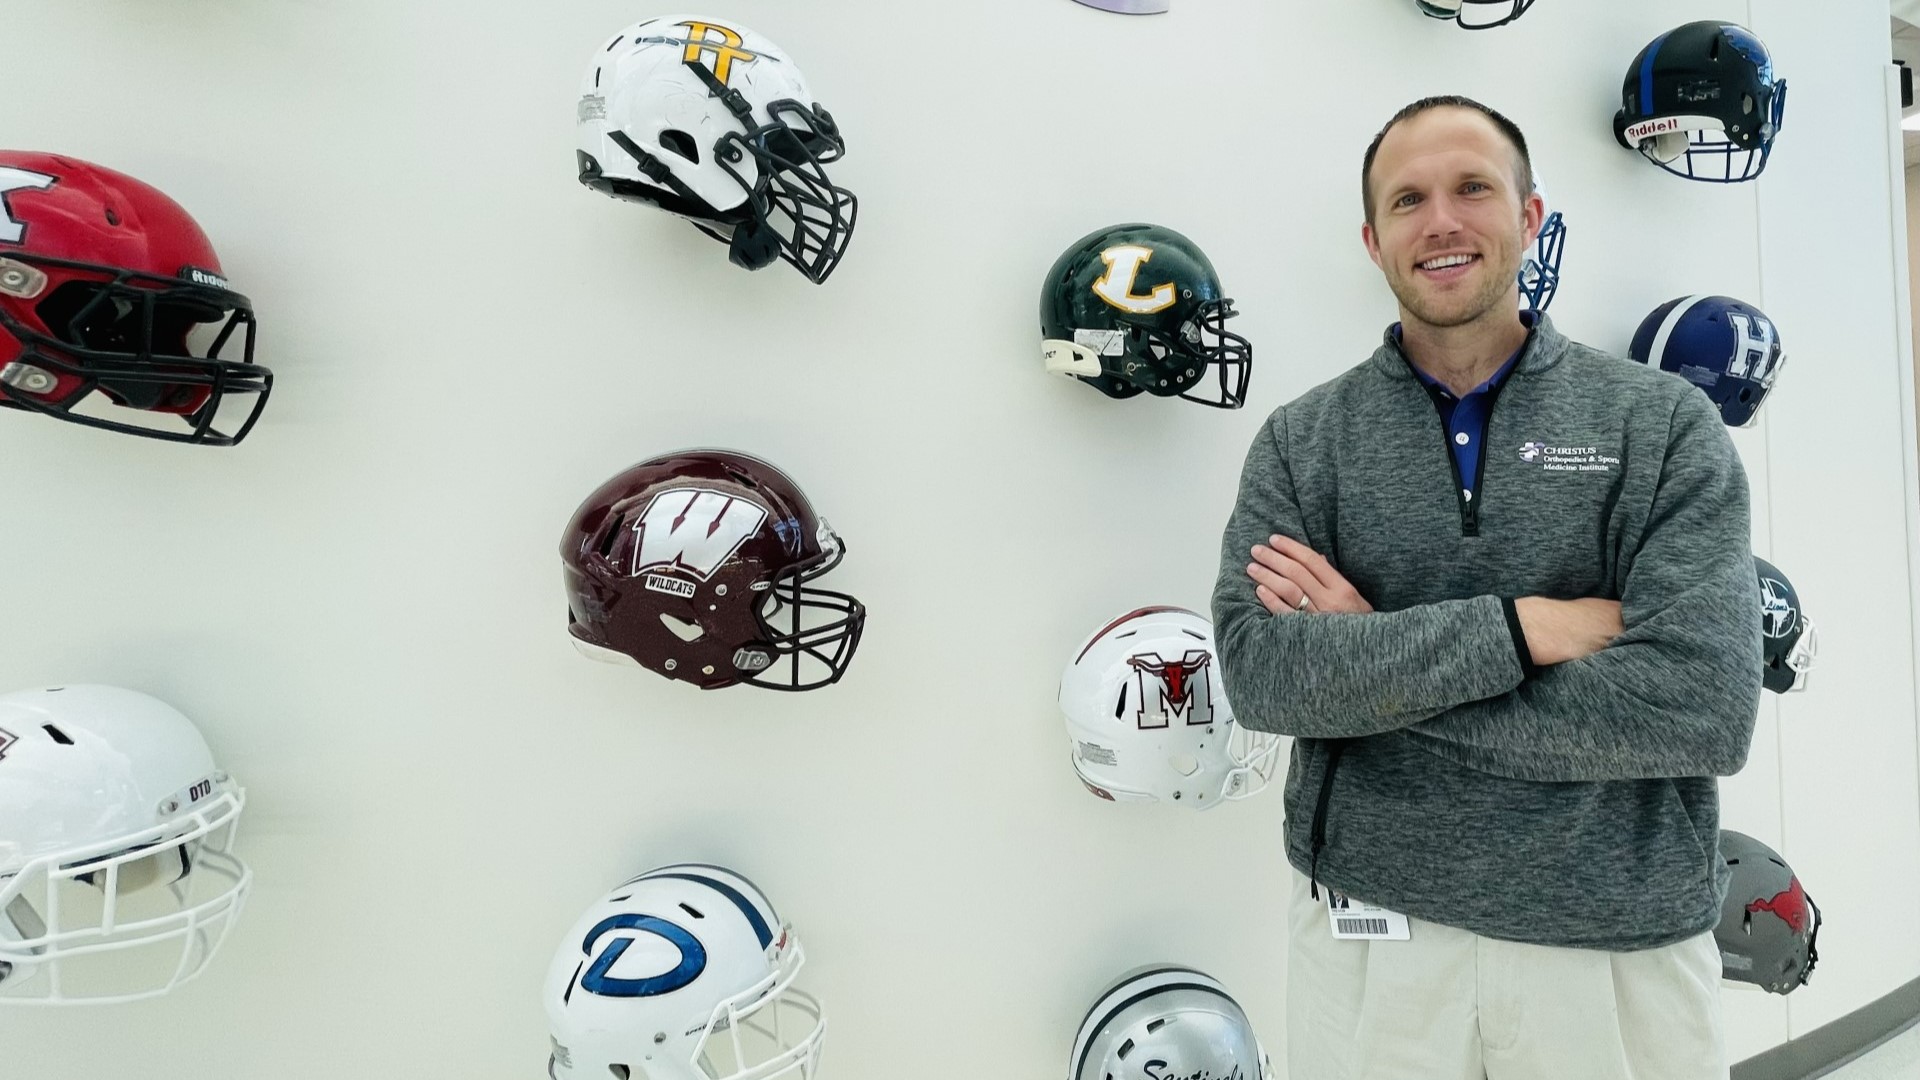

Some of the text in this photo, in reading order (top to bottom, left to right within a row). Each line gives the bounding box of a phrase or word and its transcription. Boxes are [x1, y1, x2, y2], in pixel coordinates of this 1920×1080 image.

[1628, 119, 1678, 138] Riddell
[1092, 244, 1178, 315] L
[1725, 311, 1774, 383] H
[1543, 446, 1597, 455] CHRISTUS
[1543, 455, 1587, 464] Orthopedics
[1588, 455, 1596, 463] &
[1543, 463, 1609, 472] Medicine Institute
[632, 487, 769, 582] W
[648, 575, 695, 597] WILDCATS
[1765, 600, 1788, 611] Lions
[1133, 649, 1214, 730] M
[190, 779, 211, 802] DTD
[580, 913, 707, 998] D
